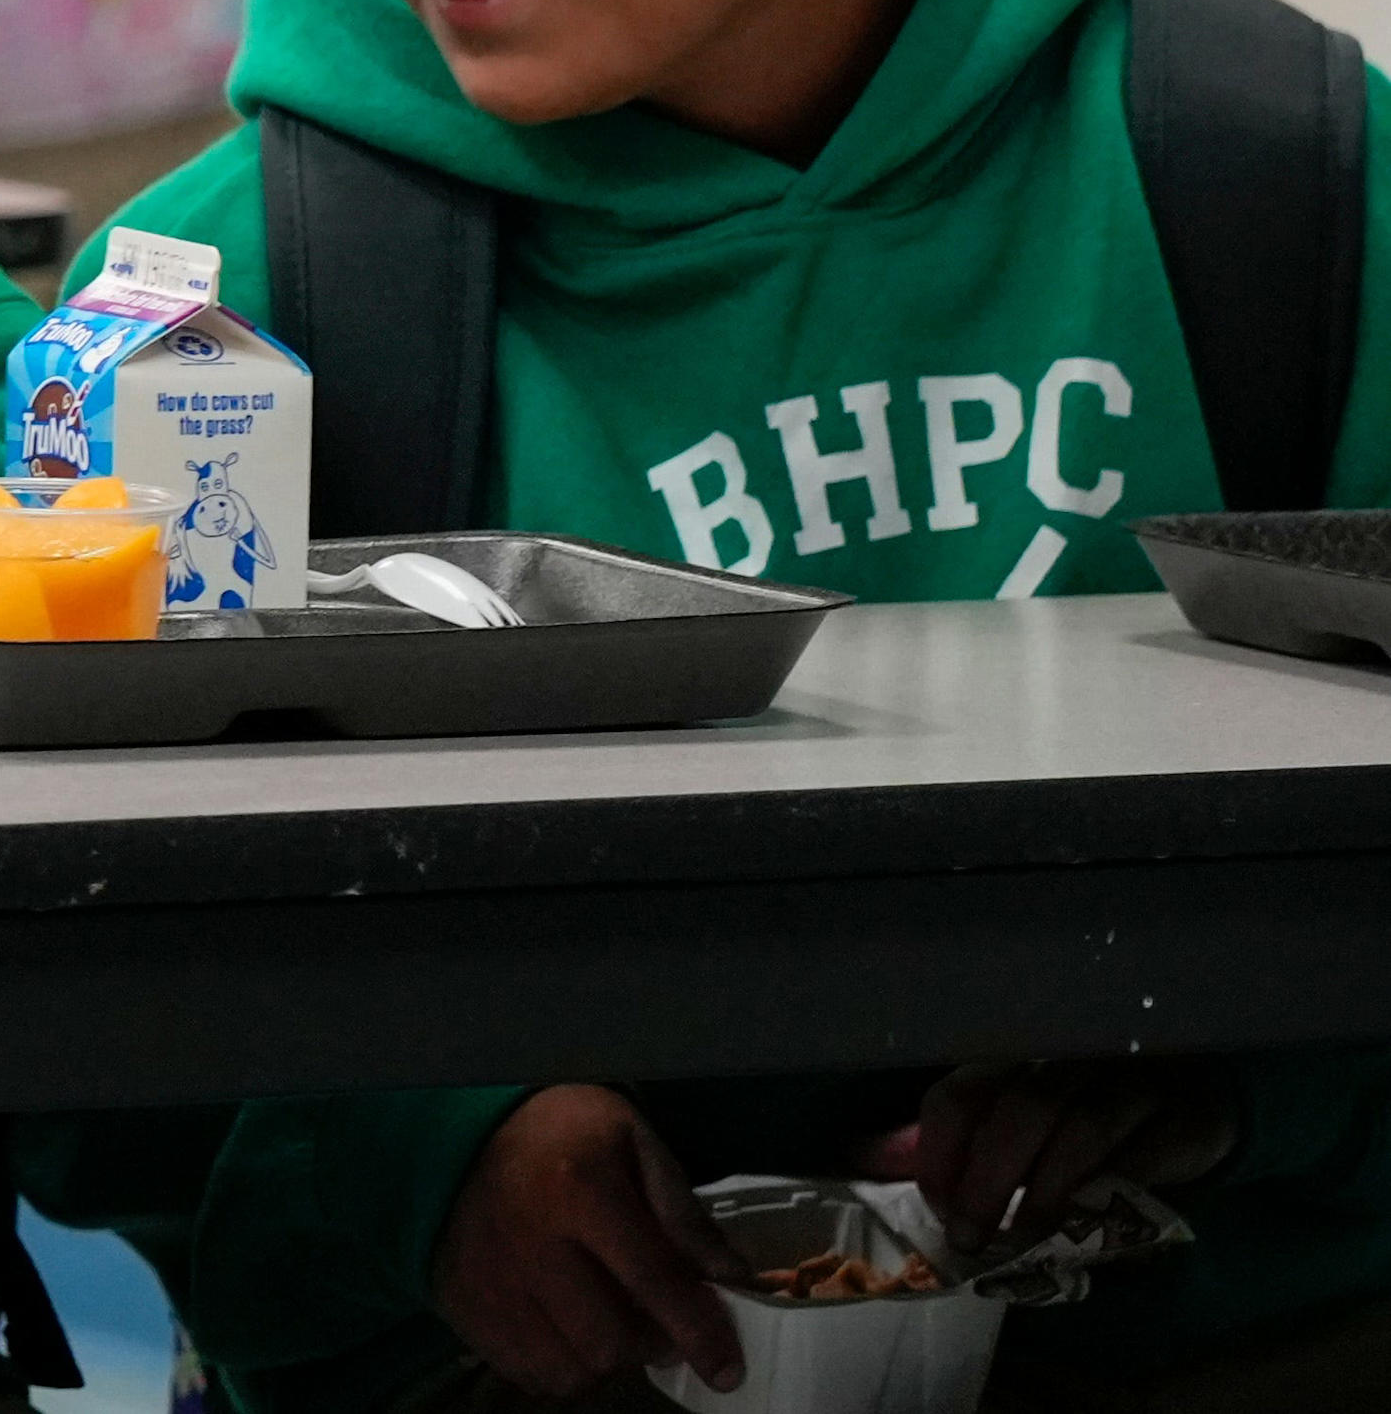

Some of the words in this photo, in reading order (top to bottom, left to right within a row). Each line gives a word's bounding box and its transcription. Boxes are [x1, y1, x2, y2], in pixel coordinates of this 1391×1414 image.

[27, 317, 94, 352] TruMoo
[156, 392, 187, 412] How
[191, 392, 208, 411] do
[212, 394, 248, 410] cows
[252, 392, 273, 410] cut
[22, 411, 90, 472] TruMoo
[180, 415, 203, 435] the
[206, 414, 254, 438] grass?
[647, 358, 1132, 578] BHPC
